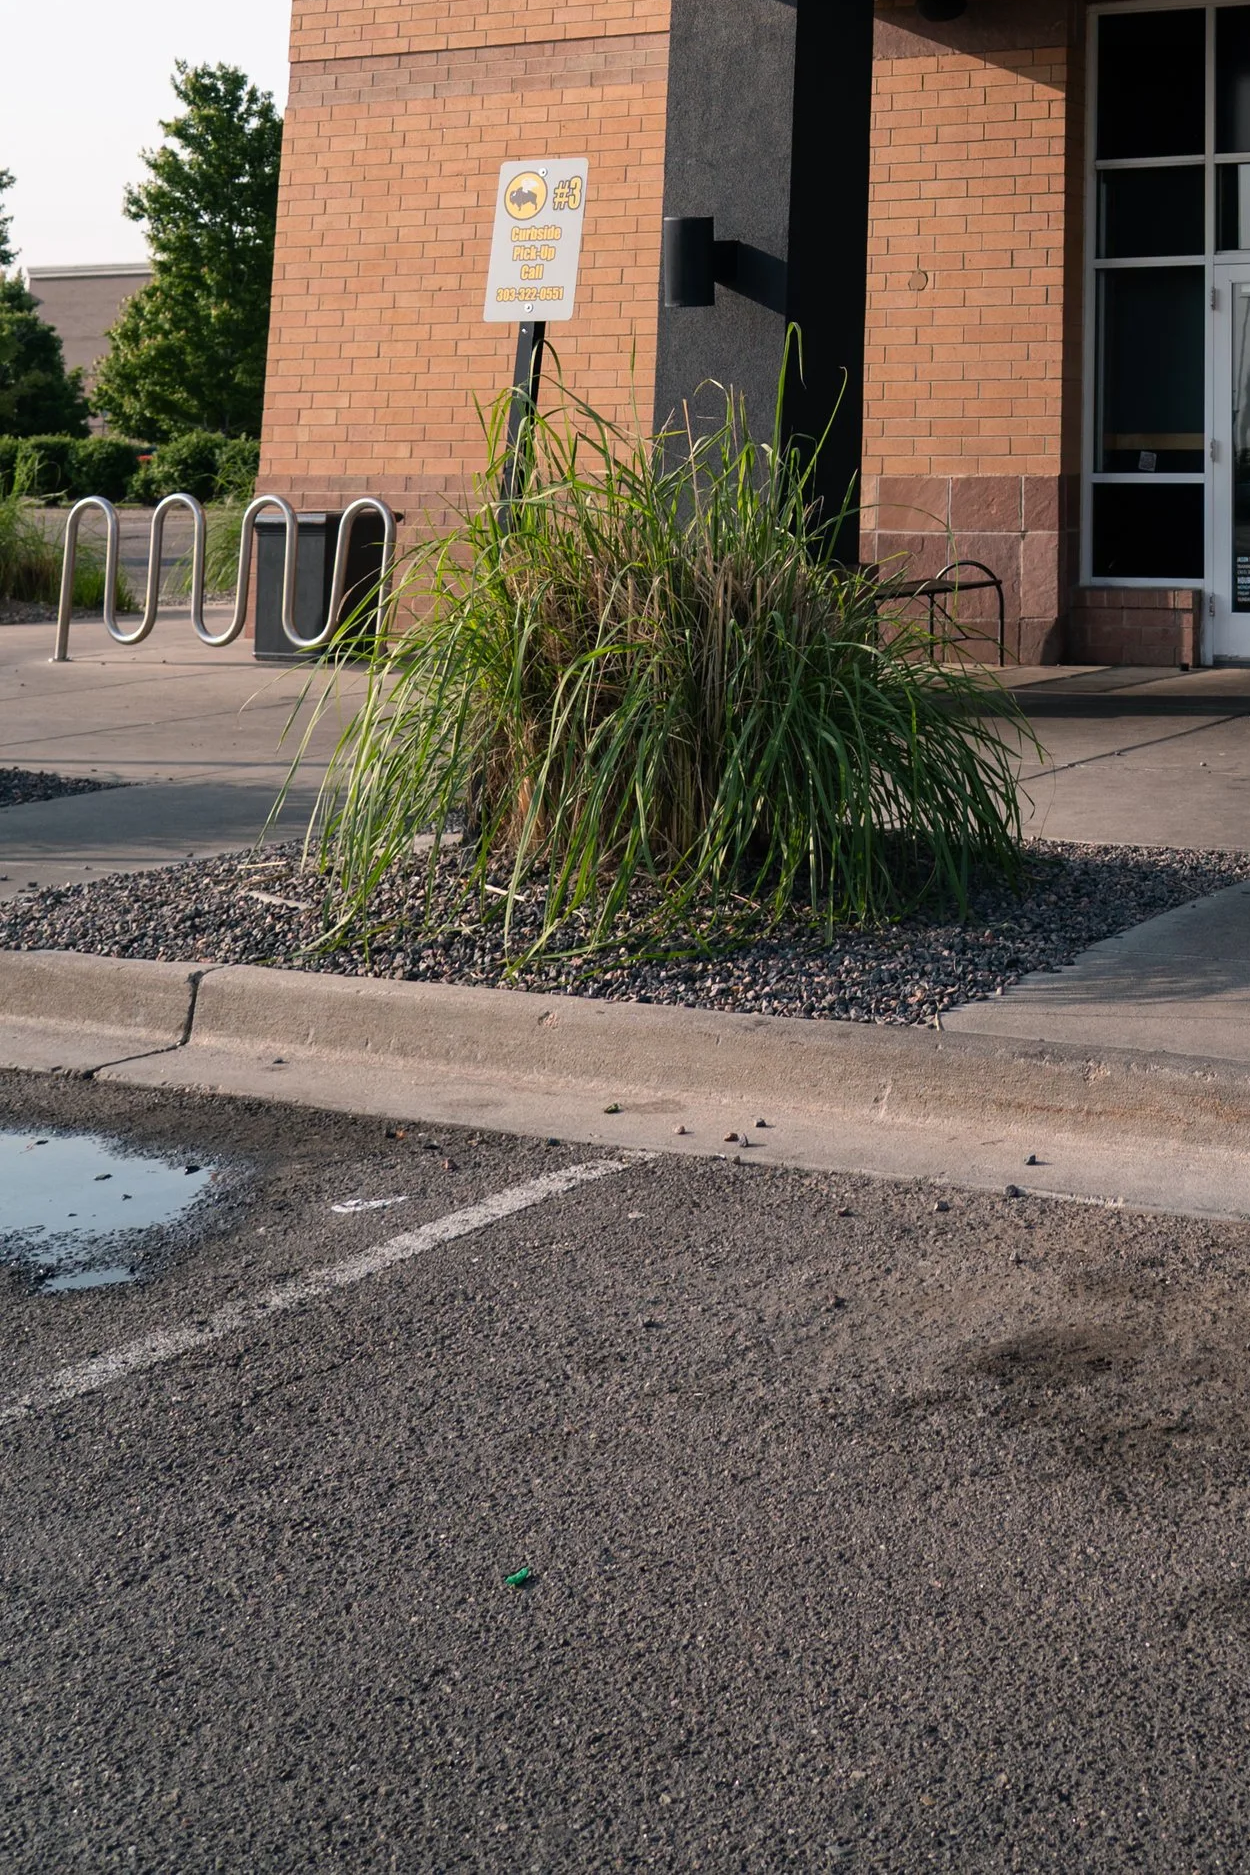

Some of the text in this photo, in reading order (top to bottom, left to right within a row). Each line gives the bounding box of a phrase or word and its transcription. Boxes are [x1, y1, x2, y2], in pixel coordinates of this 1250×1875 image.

[552, 175, 583, 211] #3
[510, 225, 562, 242] Curbside
[512, 245, 556, 262] Pick-Up
[520, 264, 544, 281] Call
[496, 286, 564, 302] 303-322-0551
